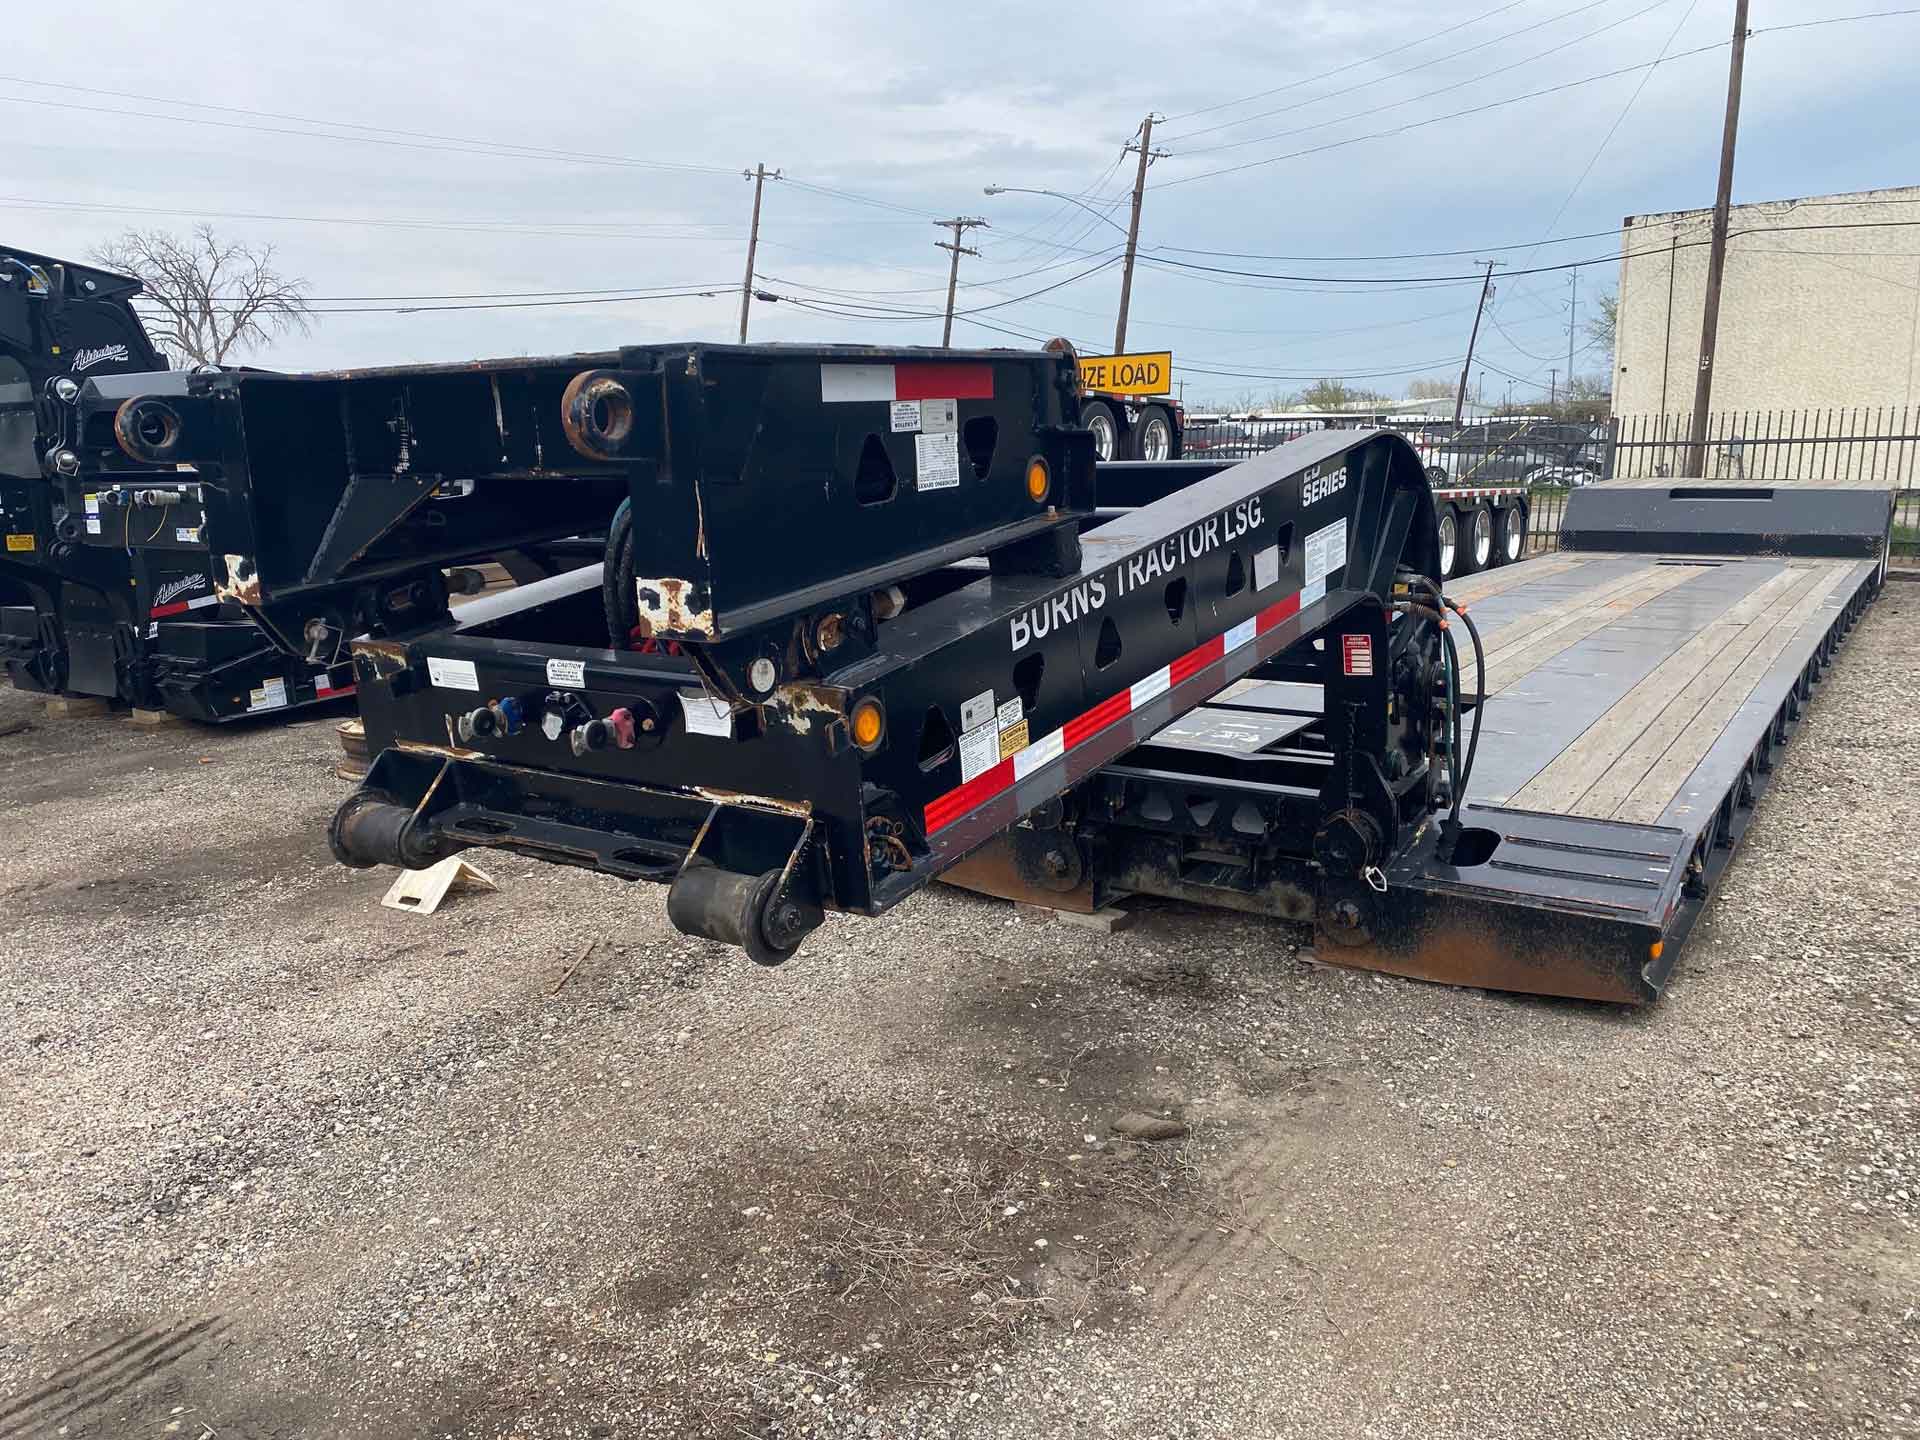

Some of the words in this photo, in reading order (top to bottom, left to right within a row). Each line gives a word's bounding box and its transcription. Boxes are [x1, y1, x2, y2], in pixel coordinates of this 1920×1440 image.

[1080, 365, 1106, 388] IZE
[1112, 362, 1160, 387] LOAD
[1302, 466, 1347, 507] SERIES
[1010, 574, 1106, 651] BURNS
[1117, 517, 1219, 597] TRACTOR
[1224, 496, 1265, 543] LSG.
